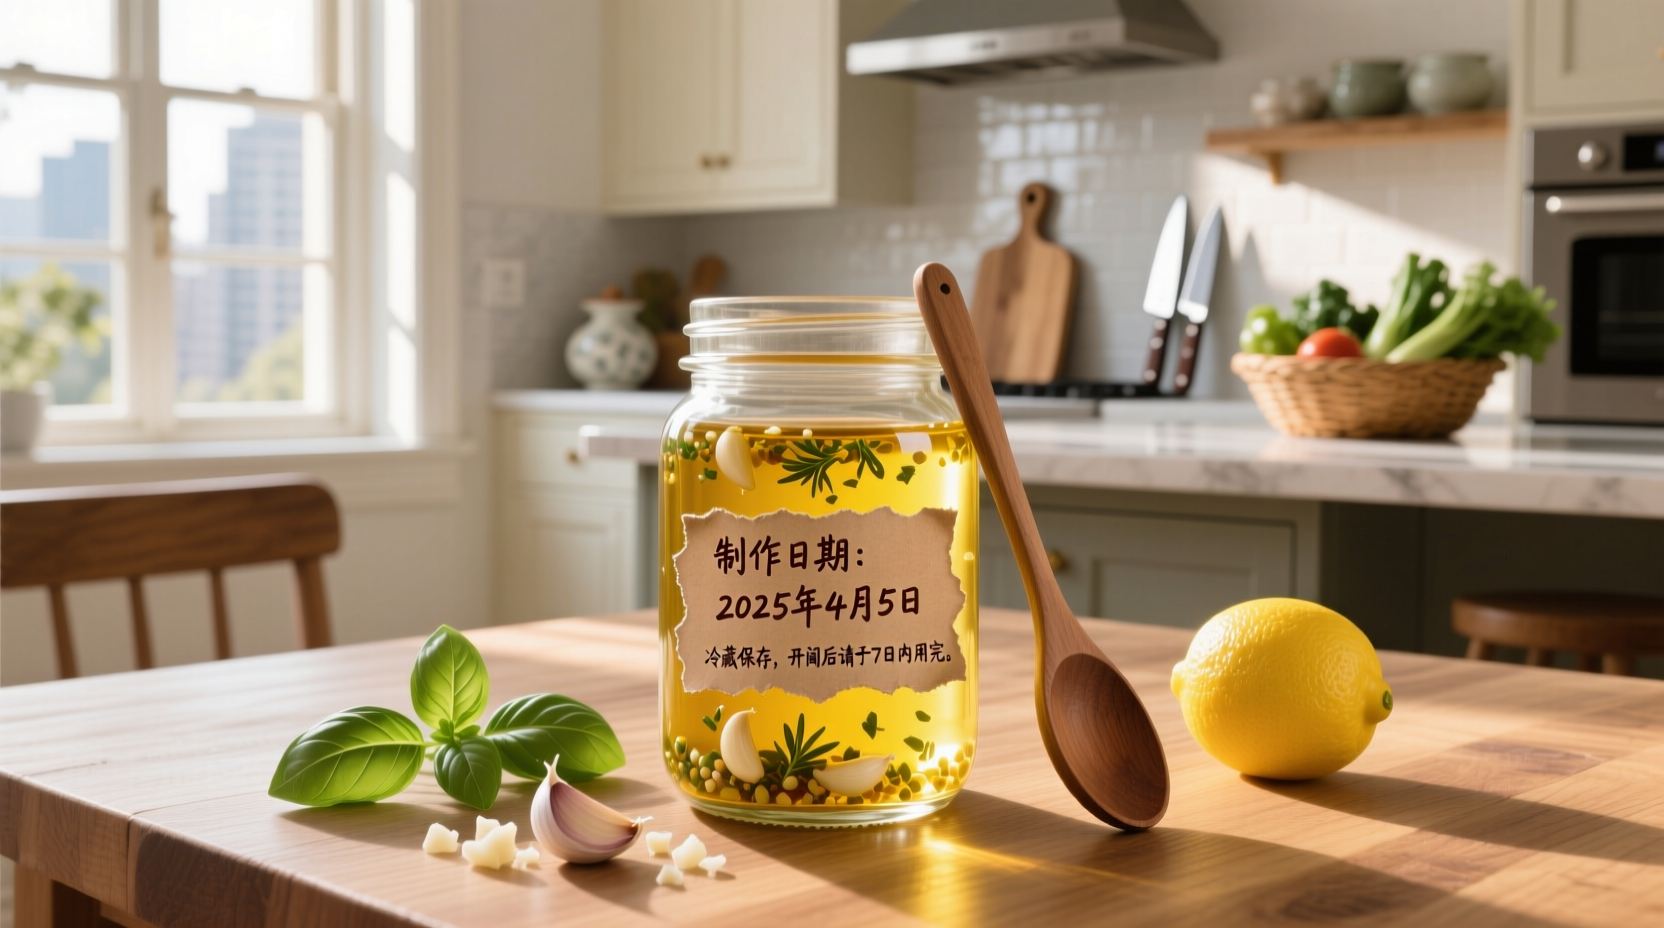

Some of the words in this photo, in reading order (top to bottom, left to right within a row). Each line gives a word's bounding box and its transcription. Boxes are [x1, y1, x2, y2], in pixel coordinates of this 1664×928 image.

[713, 533, 865, 577] 制作日期：
[716, 584, 920, 628] 2025年4月5日
